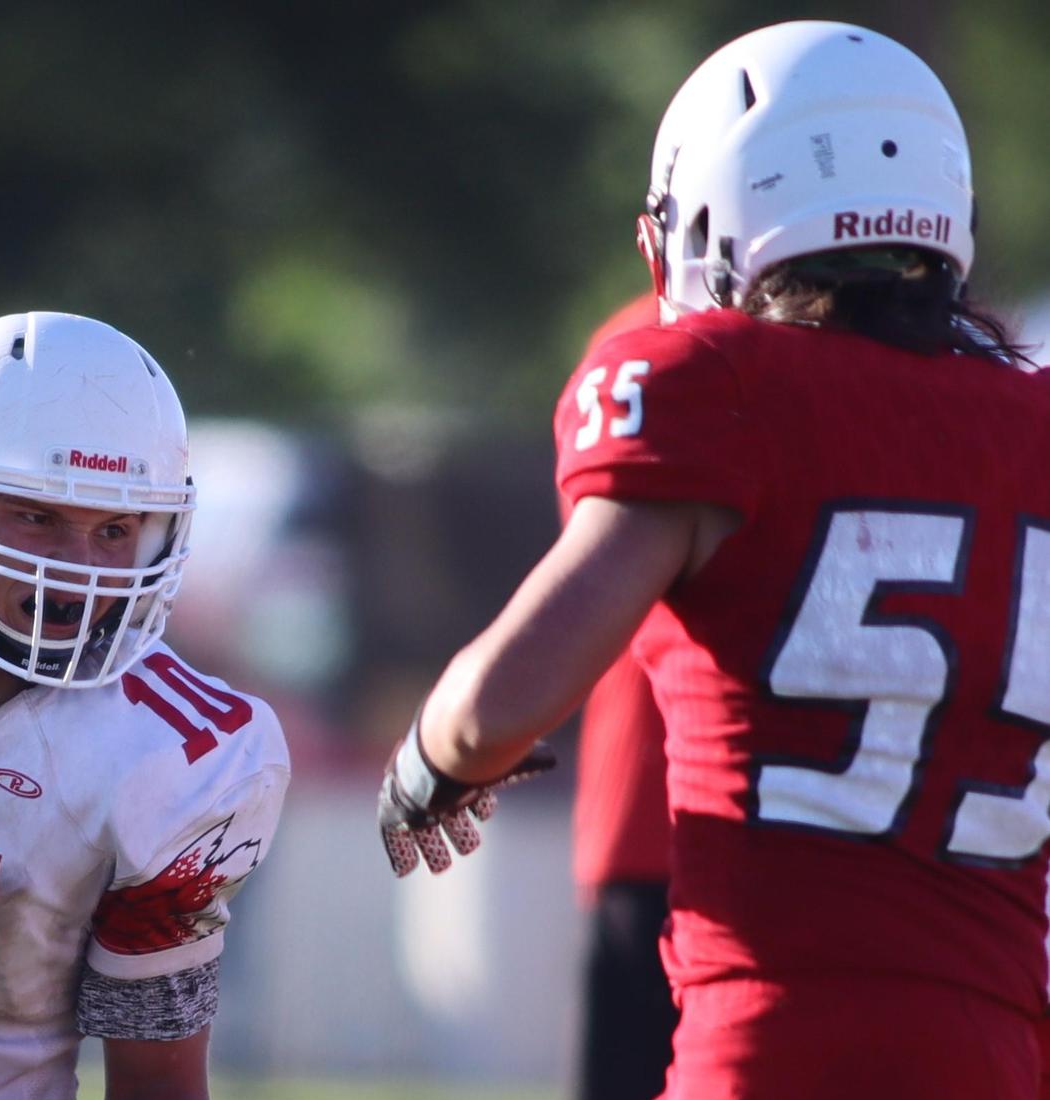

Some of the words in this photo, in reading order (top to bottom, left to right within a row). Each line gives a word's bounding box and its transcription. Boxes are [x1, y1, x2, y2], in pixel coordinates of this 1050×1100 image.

[833, 208, 951, 244] Riddell
[574, 360, 650, 452] 55
[69, 449, 128, 474] Riddell
[121, 651, 253, 766] 10
